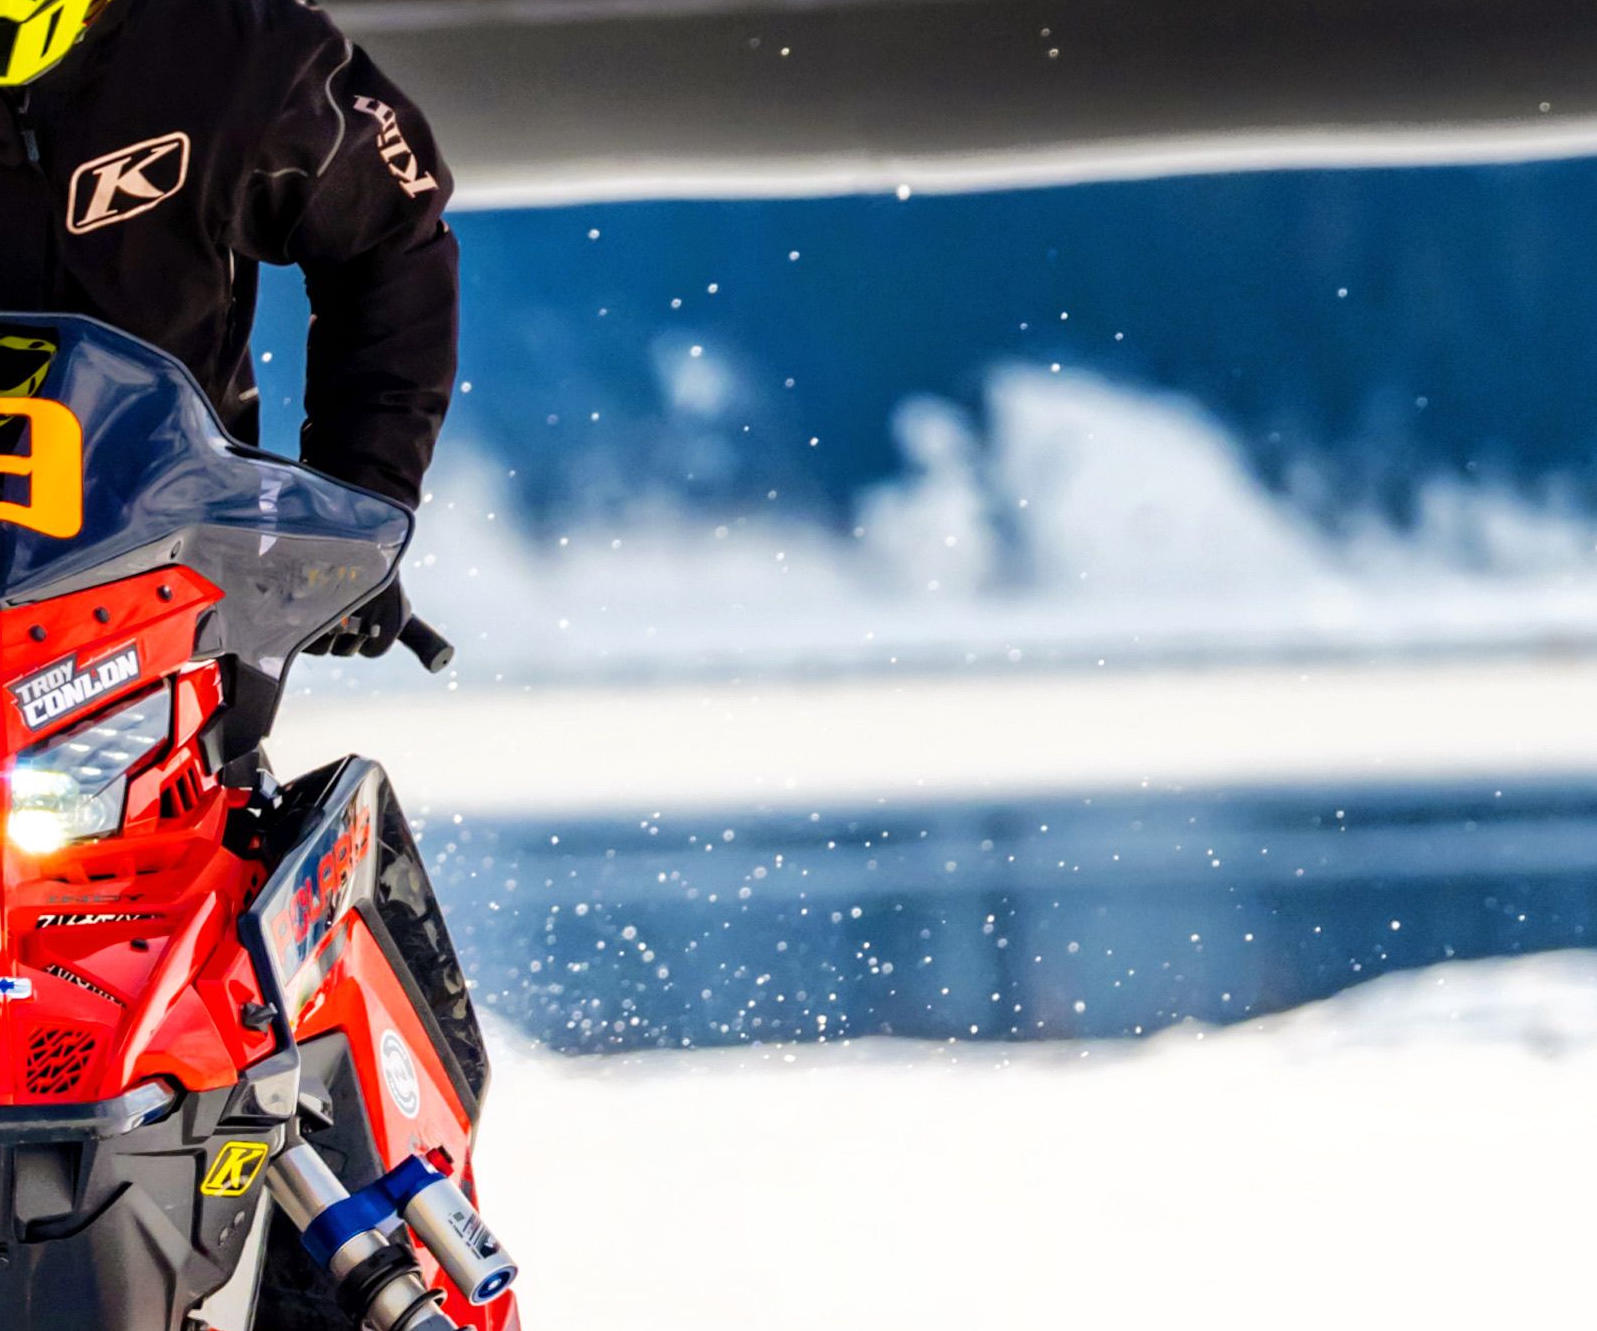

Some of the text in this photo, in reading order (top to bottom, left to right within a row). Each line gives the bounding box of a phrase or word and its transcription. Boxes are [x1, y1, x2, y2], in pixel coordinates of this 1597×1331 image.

[76, 141, 180, 227] K
[15, 660, 74, 704] TROY
[23, 650, 139, 727] CONLON
[271, 807, 371, 965] POLARIS
[205, 1147, 264, 1189] K
